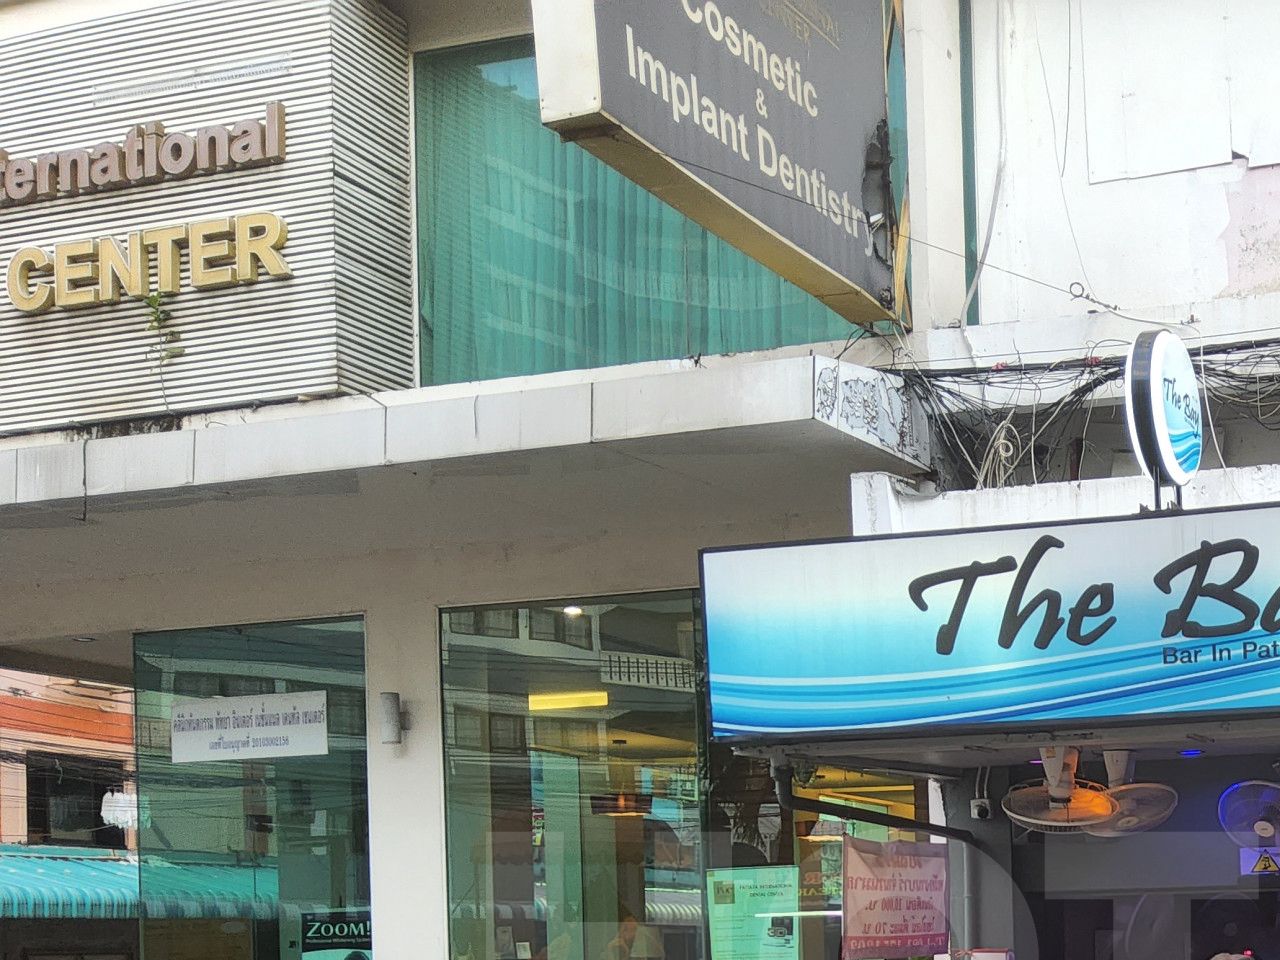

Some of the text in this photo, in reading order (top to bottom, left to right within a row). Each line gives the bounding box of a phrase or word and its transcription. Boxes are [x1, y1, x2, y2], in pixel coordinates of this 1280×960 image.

[755, 87, 768, 119] &
[625, 23, 874, 257] Implant Dentistry
[6, 210, 294, 313] CENTER
[1163, 377, 1182, 410] The
[1183, 393, 1201, 439] Bay
[908, 534, 1118, 656] The
[1162, 646, 1202, 664] Bar
[1212, 643, 1231, 662] In
[306, 920, 372, 937] ZOOM!
